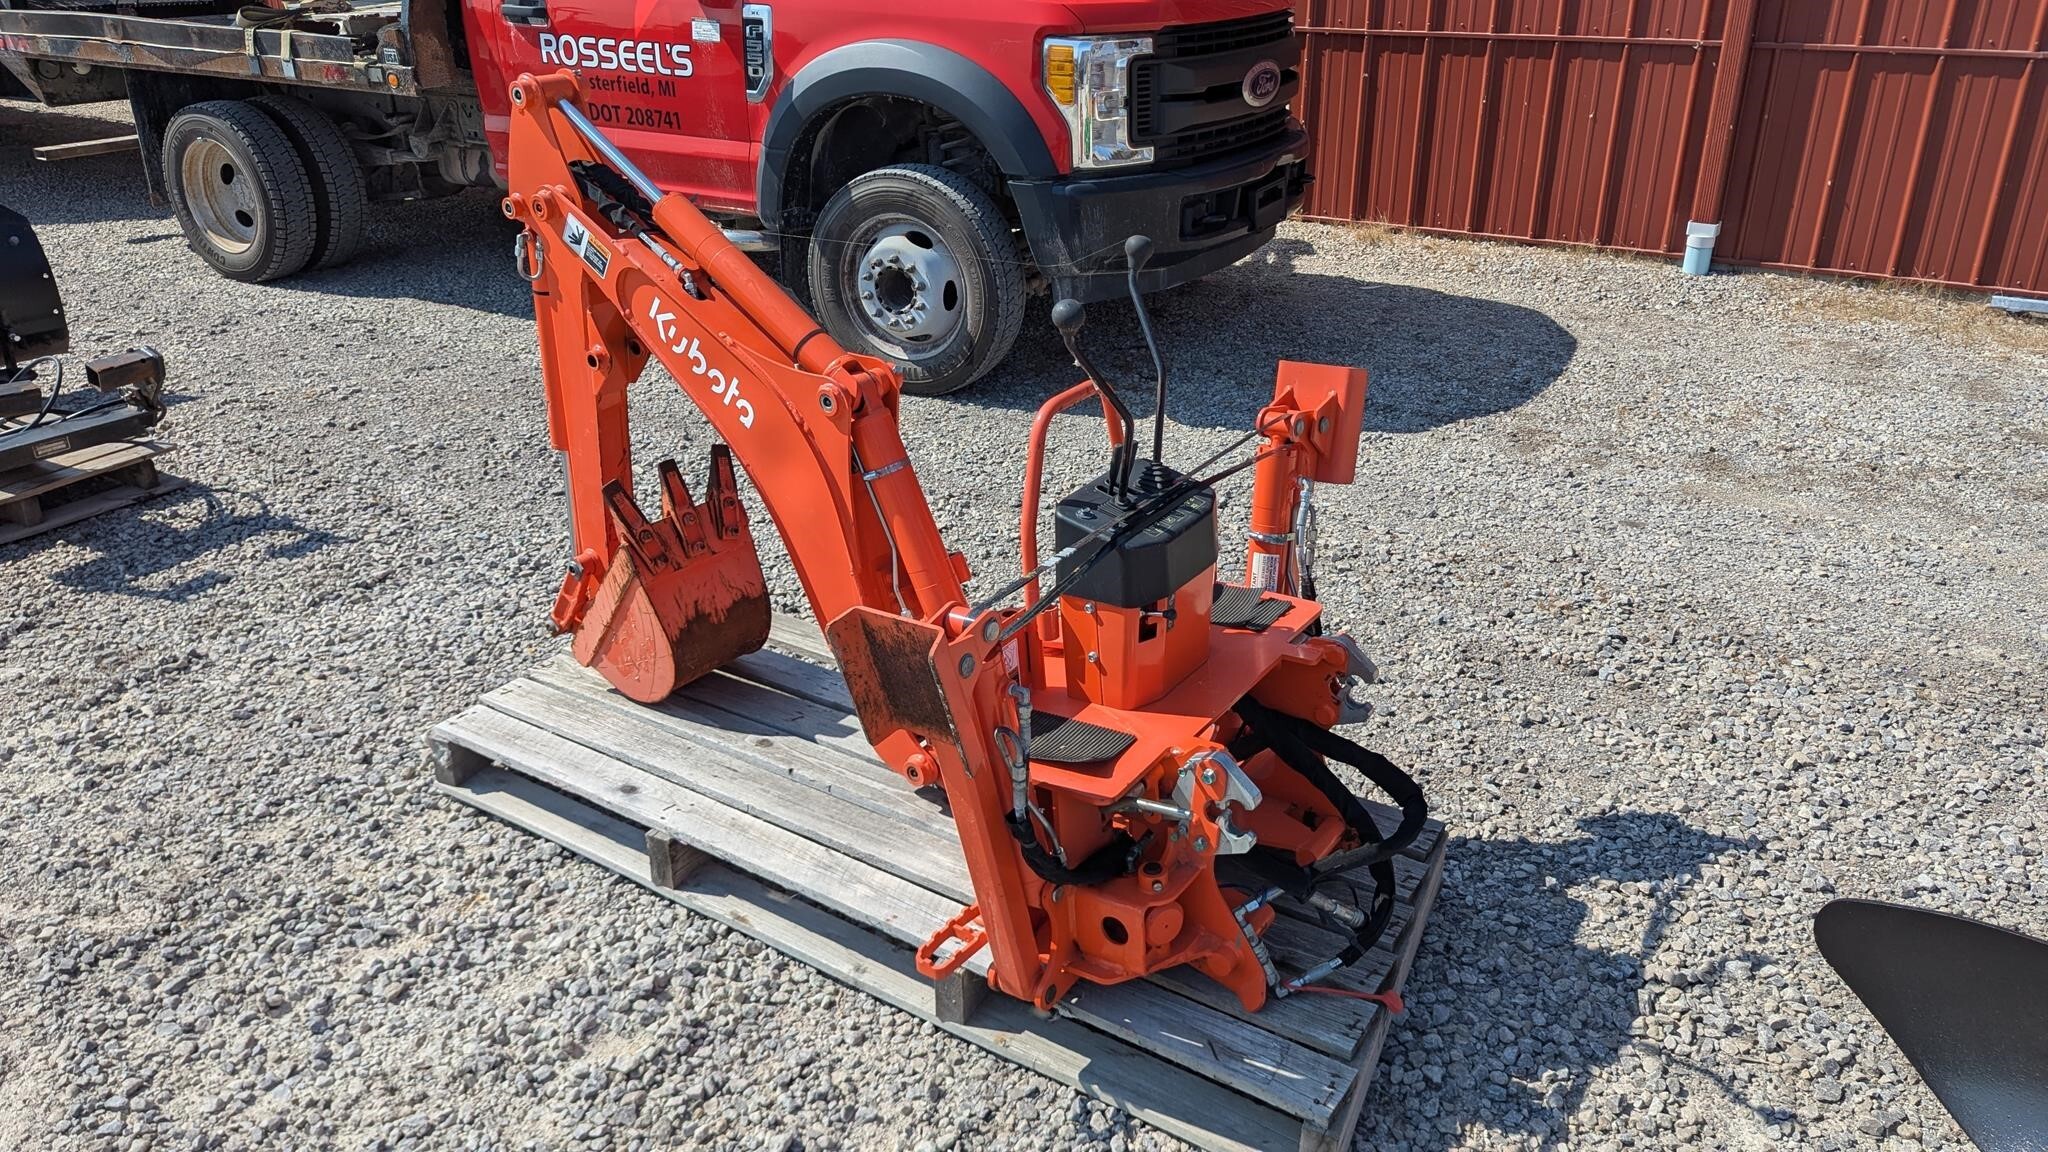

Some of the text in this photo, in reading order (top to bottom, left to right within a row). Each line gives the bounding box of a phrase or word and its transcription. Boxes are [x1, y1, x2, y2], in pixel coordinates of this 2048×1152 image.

[539, 32, 693, 77] ROSSEEL'S
[589, 75, 677, 98] sterfield, MI
[588, 103, 682, 130] DOT 208741
[648, 296, 755, 430] Kubota
